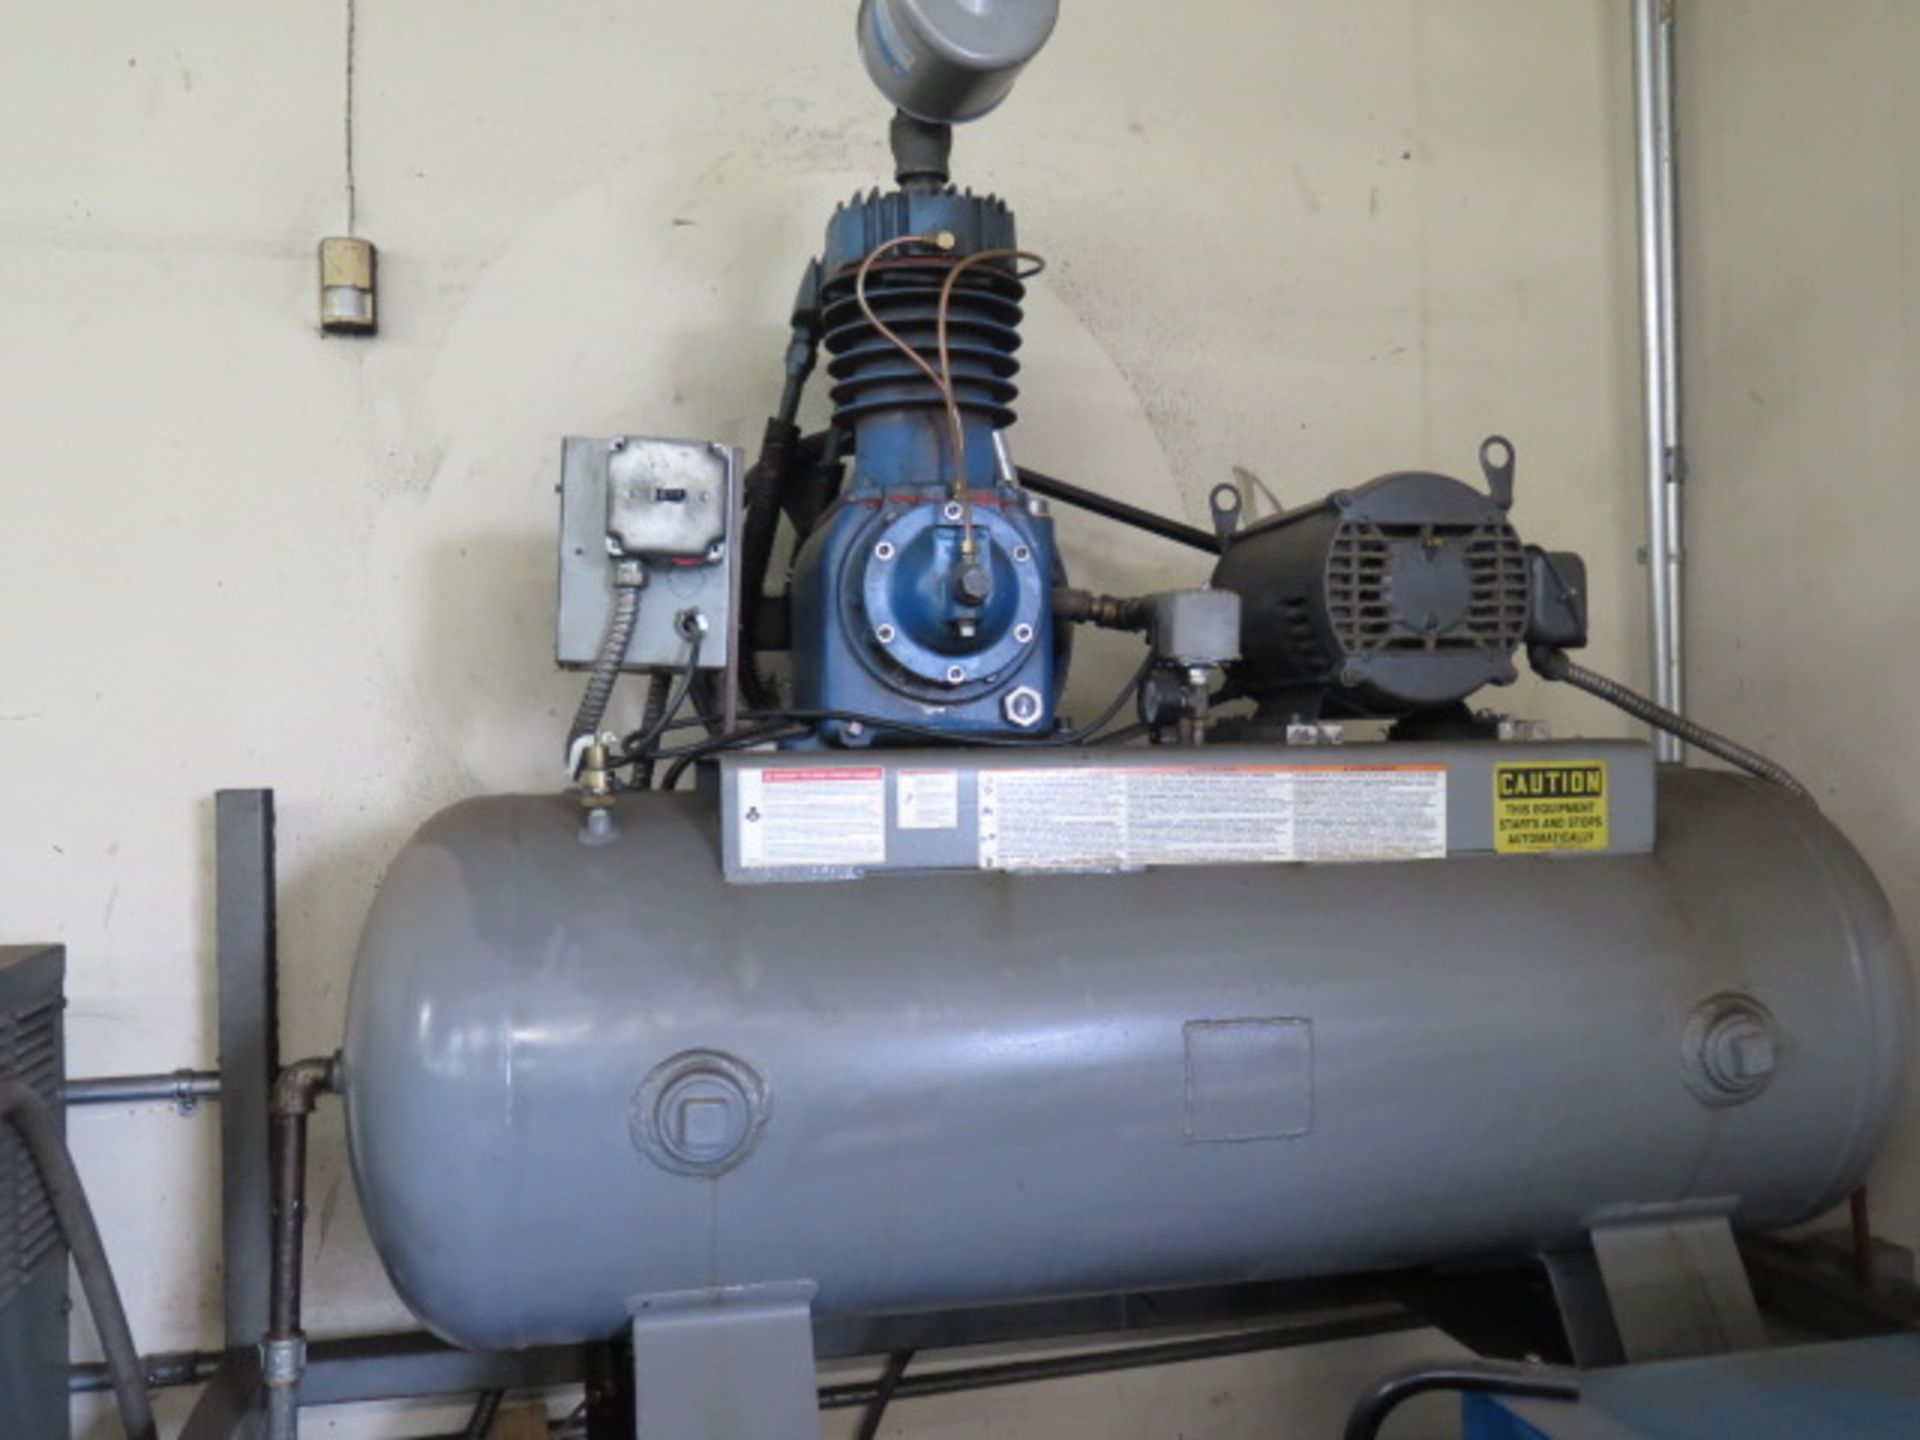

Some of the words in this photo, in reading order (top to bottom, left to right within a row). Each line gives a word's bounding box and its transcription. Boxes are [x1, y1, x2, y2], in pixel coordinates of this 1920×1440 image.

[1501, 771, 1600, 795] CAUTION
[1506, 803, 1530, 815] THIS
[1533, 801, 1595, 814] EQUIPMENT
[1500, 818, 1540, 831] STARTS
[1542, 817, 1565, 829] AND
[1568, 816, 1602, 829] STOPS
[1508, 832, 1595, 845] AUTOMATICALLY
